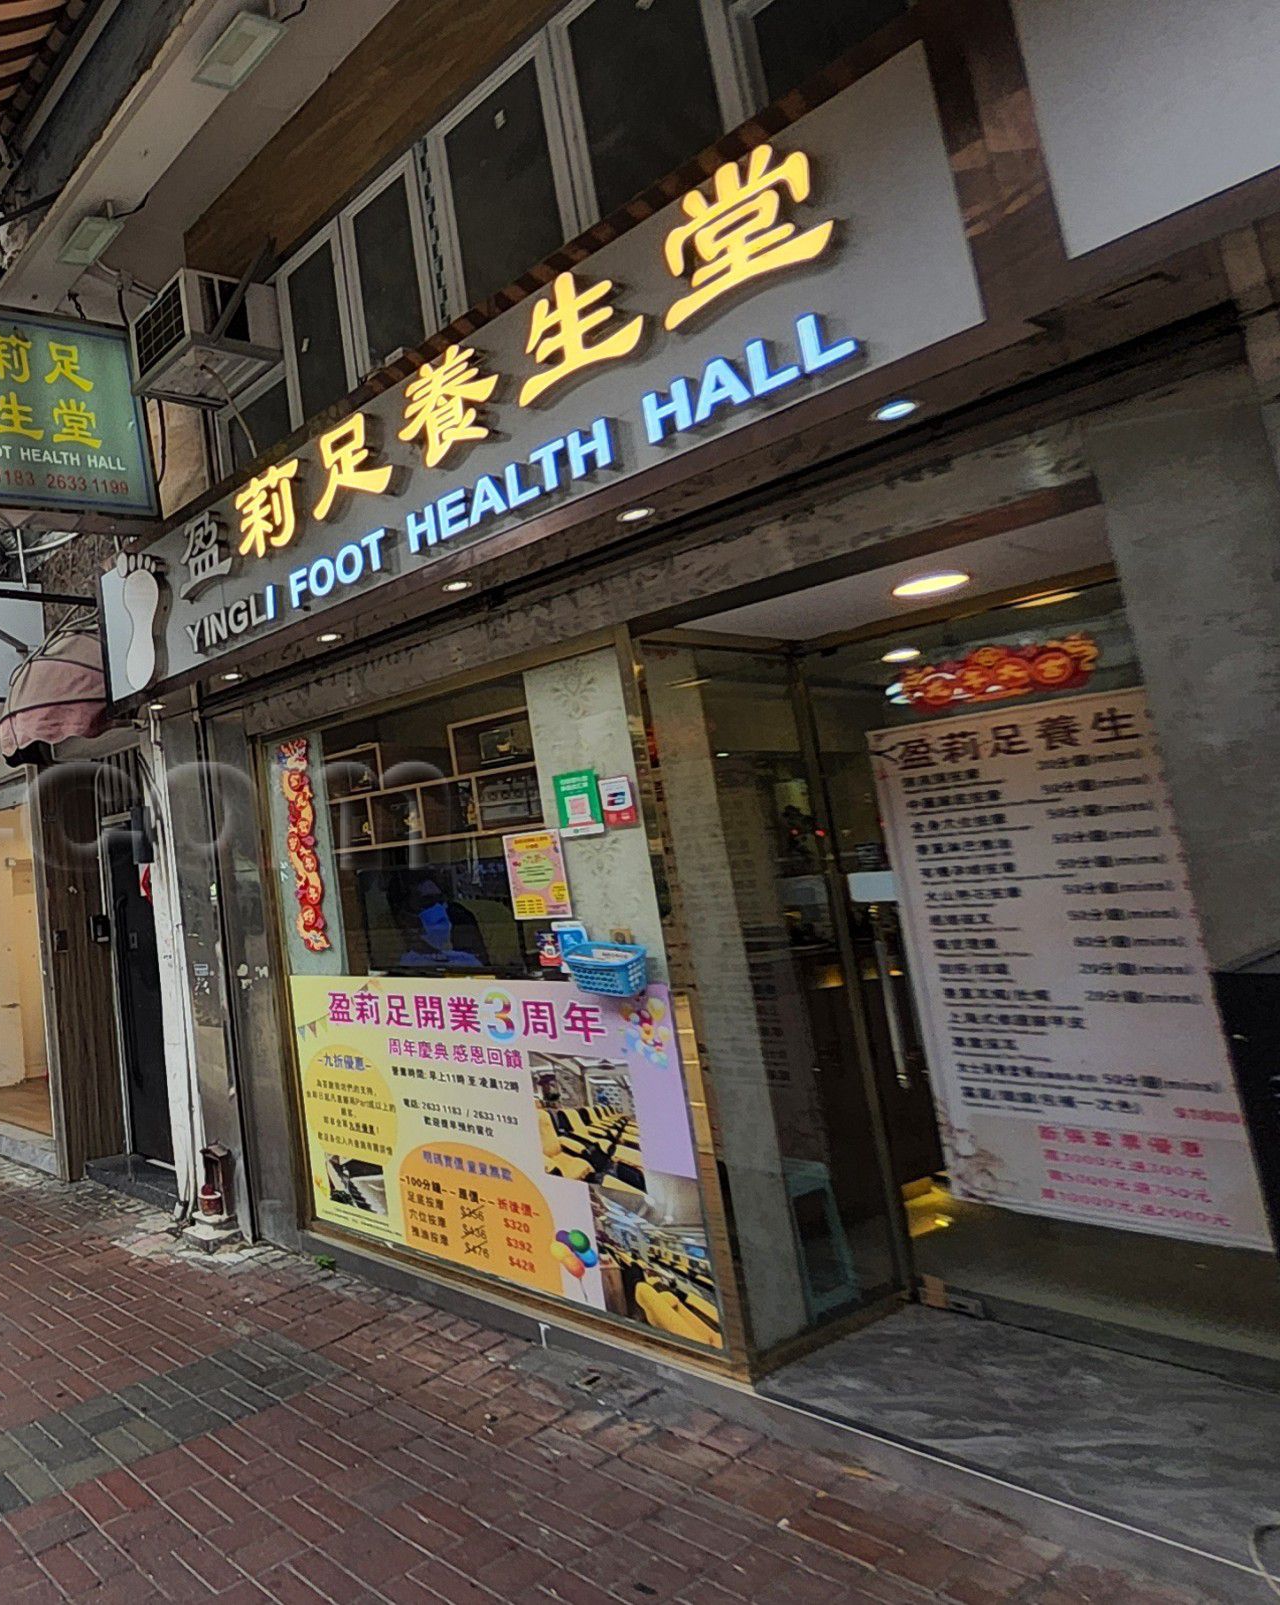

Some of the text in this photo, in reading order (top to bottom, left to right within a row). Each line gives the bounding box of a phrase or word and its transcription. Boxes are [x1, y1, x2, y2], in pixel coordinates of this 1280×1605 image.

[180, 143, 835, 597] 盈莉足養生堂
[20, 447, 81, 467] HEALTH
[87, 454, 126, 471] HALL
[46, 473, 87, 491] 2633
[185, 311, 859, 655] YINGLI FOOT HEALTH HALL
[896, 707, 1143, 771] 盈莉足養生
[327, 988, 607, 1043] 盈莉足開業3周年
[388, 1038, 523, 1070] 周年慶典 感恩回饋
[503, 1217, 530, 1234] $320
[505, 1236, 534, 1254] $392
[508, 1255, 536, 1274] $428
